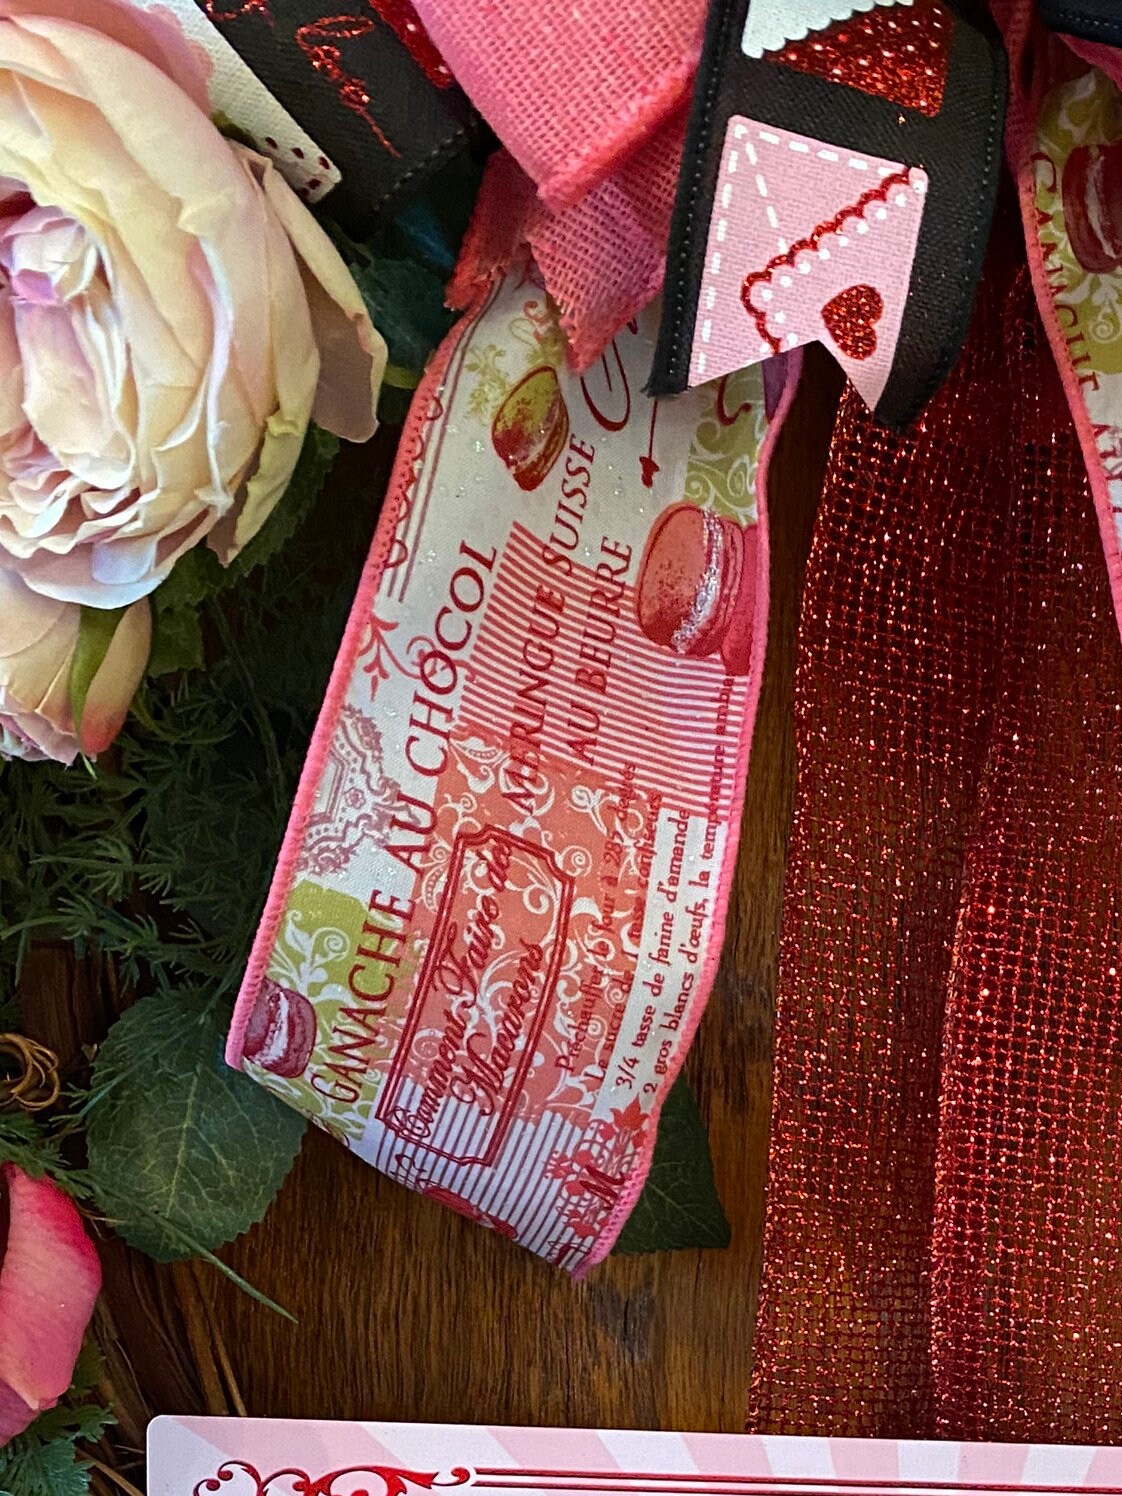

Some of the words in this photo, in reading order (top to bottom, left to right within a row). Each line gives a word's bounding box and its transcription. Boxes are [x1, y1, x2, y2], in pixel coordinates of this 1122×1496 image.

[502, 585, 564, 815] MERINGUE
[540, 434, 595, 577] SUISSE
[573, 535, 633, 694] BEURRE
[404, 541, 498, 775] CHOCOL
[566, 699, 601, 766] AU
[385, 790, 441, 874] AU
[656, 808, 691, 903] d'amande
[600, 873, 618, 886] à
[689, 870, 710, 888] la
[591, 893, 615, 934] four
[627, 895, 646, 940] tasse
[585, 941, 610, 957] le
[650, 911, 675, 965] farine
[311, 889, 416, 1104] GANACHE
[612, 969, 634, 994] de
[643, 972, 665, 997] de
[659, 971, 694, 1030] blancs
[389, 1010, 471, 1138] Comment
[430, 894, 498, 1007] Faire
[450, 937, 545, 1116] Macarons
[603, 1001, 626, 1052] sucre
[629, 1005, 657, 1048] tasse
[583, 1059, 608, 1079] Le
[614, 1055, 641, 1089] 3/4
[653, 1039, 672, 1075] gros
[643, 1081, 657, 1094] 2
